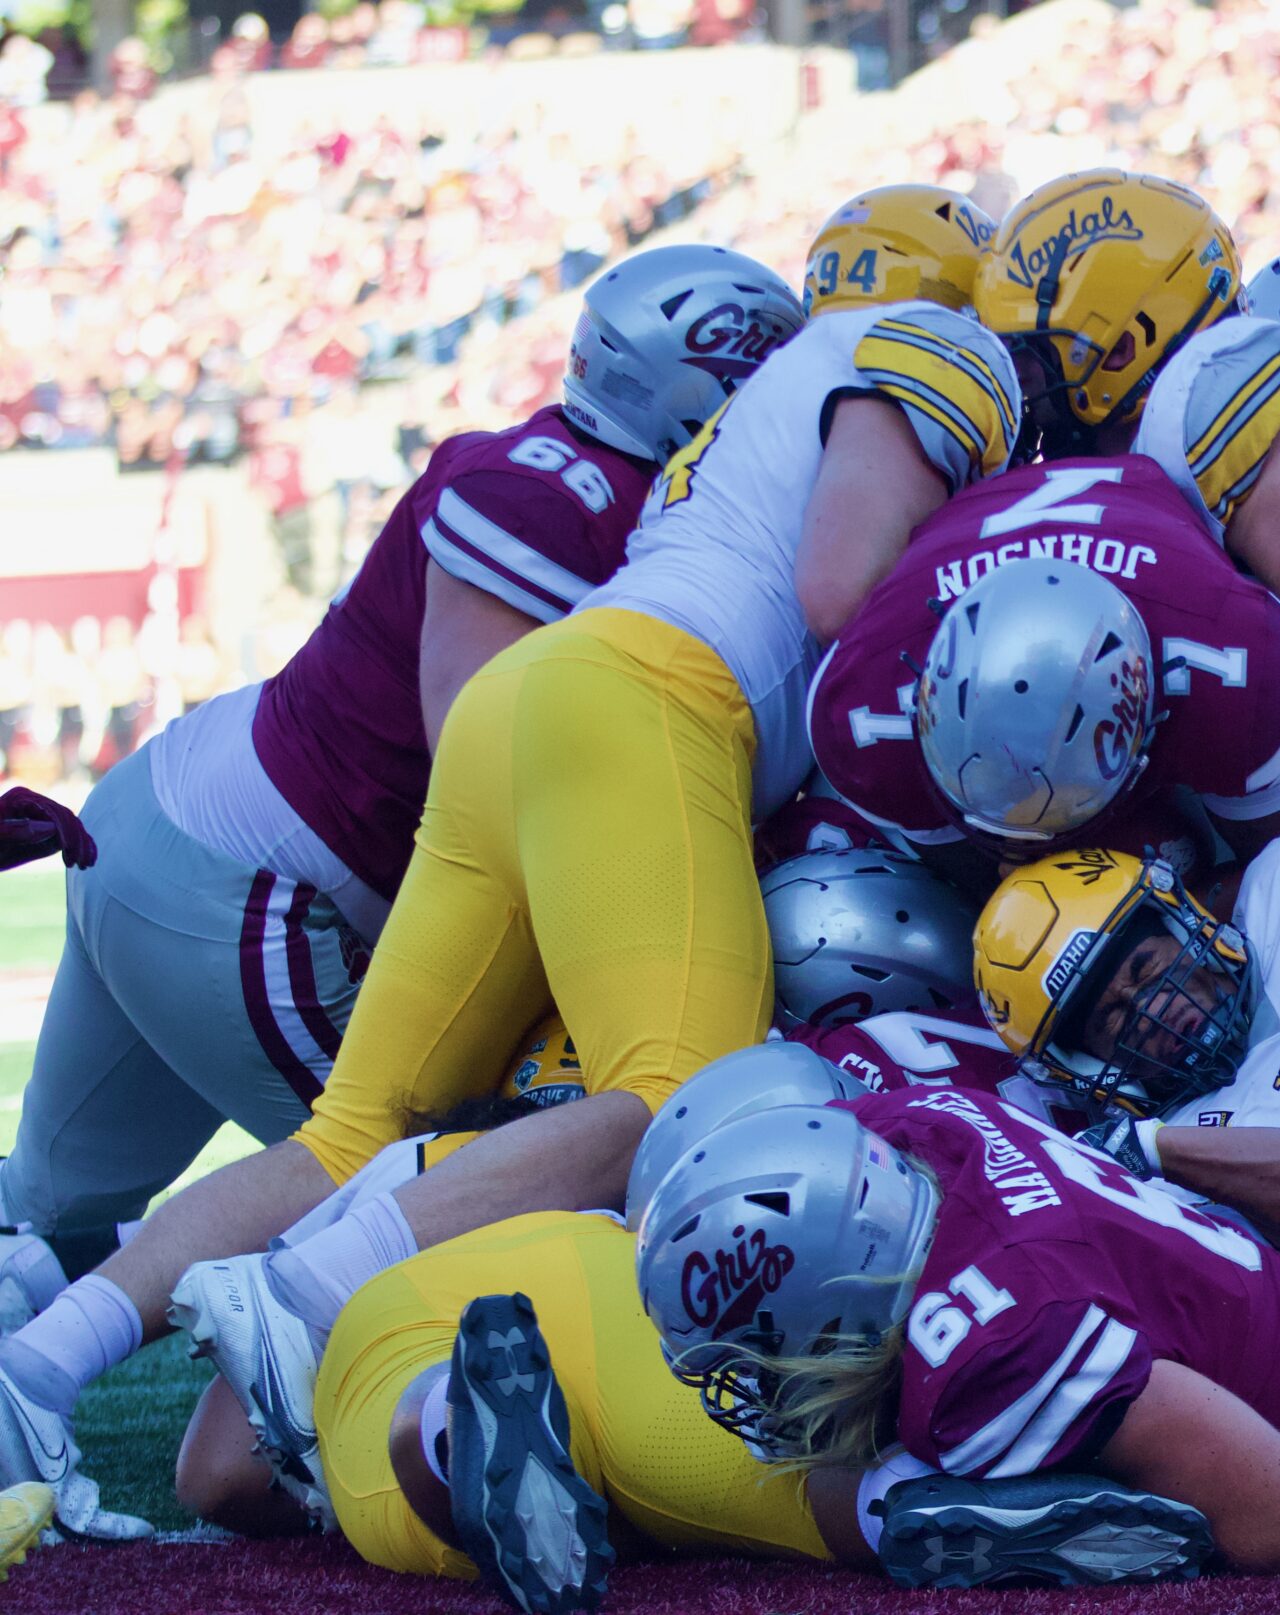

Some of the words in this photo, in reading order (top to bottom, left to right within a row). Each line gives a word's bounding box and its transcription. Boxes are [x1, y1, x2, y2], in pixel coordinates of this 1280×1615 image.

[818, 249, 878, 297] 94
[685, 303, 784, 363] Gri
[506, 435, 616, 515] 66
[1110, 1125, 1129, 1145] XXL
[681, 1224, 795, 1329] Griz
[907, 1264, 1018, 1369] 61
